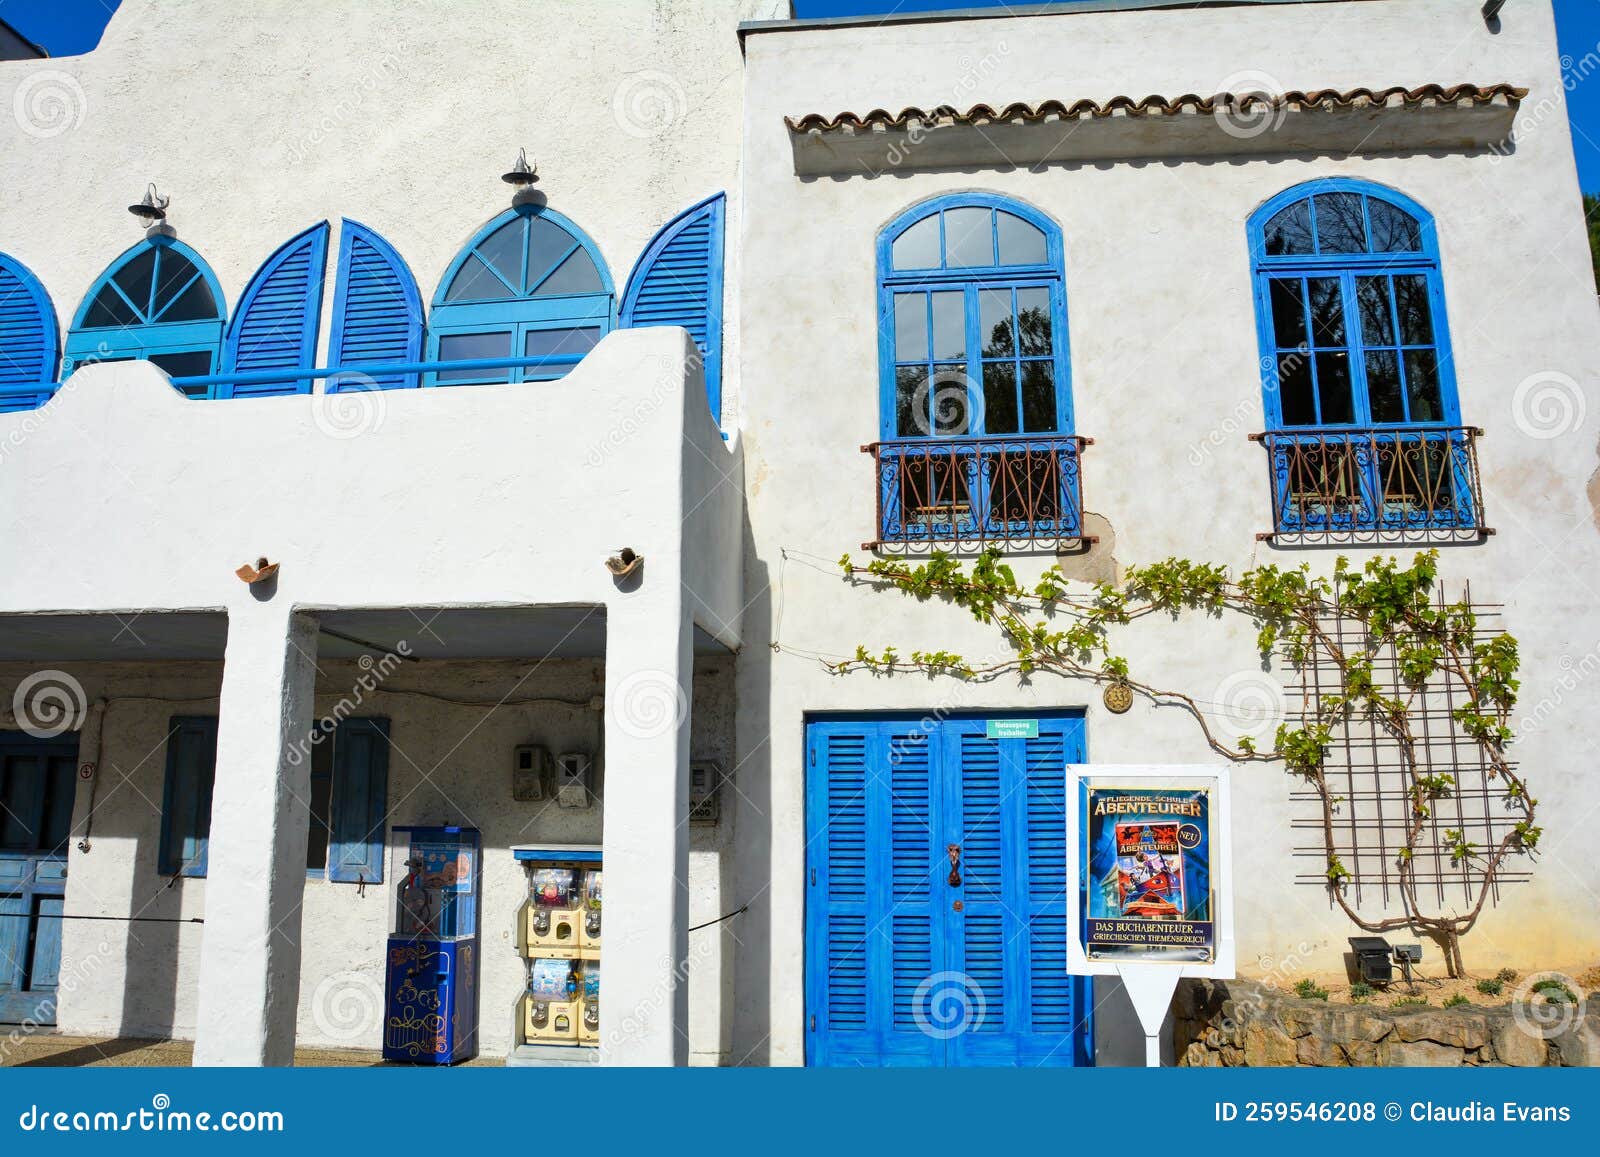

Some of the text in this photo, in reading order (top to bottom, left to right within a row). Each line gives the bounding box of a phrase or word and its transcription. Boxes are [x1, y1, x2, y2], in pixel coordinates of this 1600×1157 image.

[1094, 799, 1201, 816] ABENTEURER
[1179, 831, 1198, 842] NEU
[1095, 922, 1114, 931] DAS
[1116, 923, 1193, 934] BUCHABENTEUER
[1093, 933, 1205, 943] GRIECHISCHEN THEMENBEREICH
